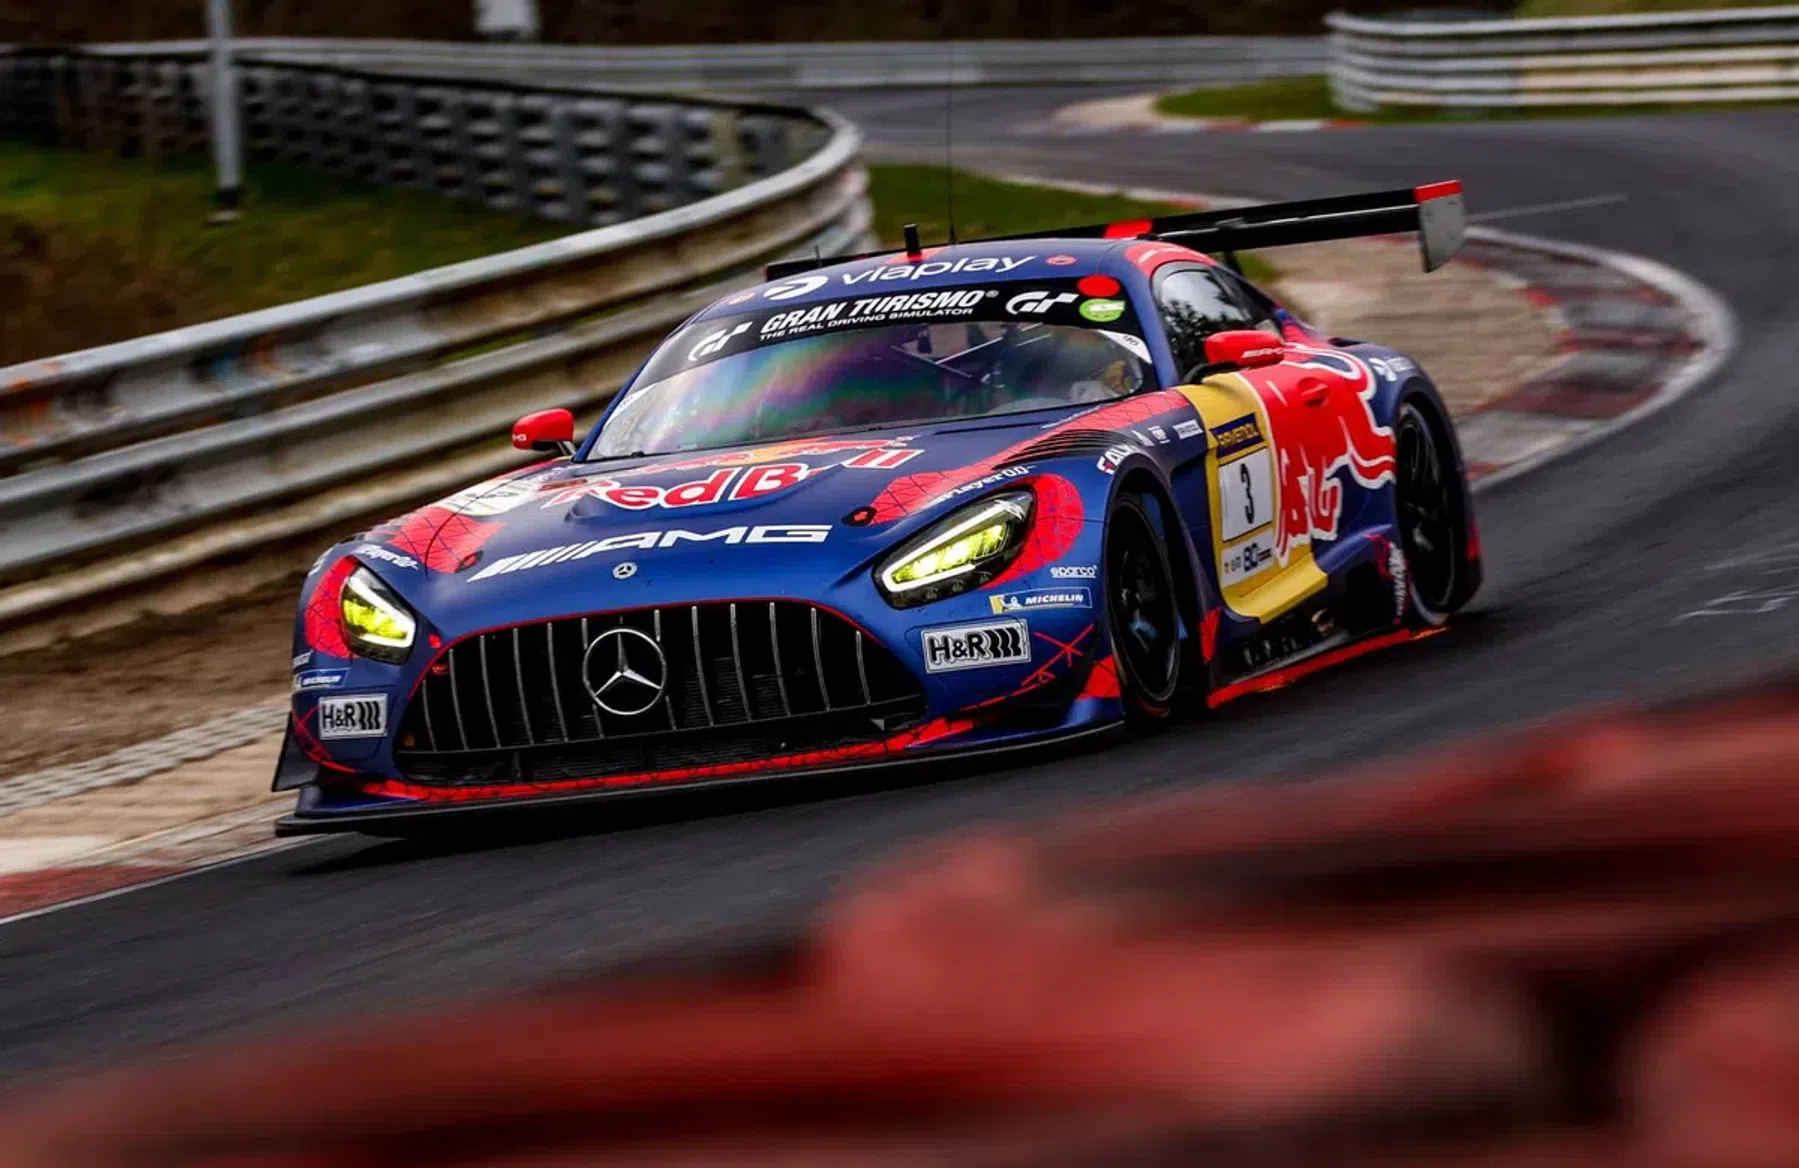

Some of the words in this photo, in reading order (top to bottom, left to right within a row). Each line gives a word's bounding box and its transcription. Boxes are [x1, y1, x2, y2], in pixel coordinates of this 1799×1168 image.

[841, 255, 1036, 285] viaplay
[759, 329, 785, 341] THE
[789, 324, 823, 335] REAL
[828, 314, 885, 328] DRIVING
[888, 308, 974, 320] SIMULATOR
[760, 301, 849, 334] GRAN
[541, 467, 735, 509] Red
[1240, 463, 1255, 524] 3
[580, 525, 832, 561] AMG
[1025, 594, 1084, 605] MICHELIN
[928, 630, 988, 665] H&R
[321, 702, 357, 729] H&R
